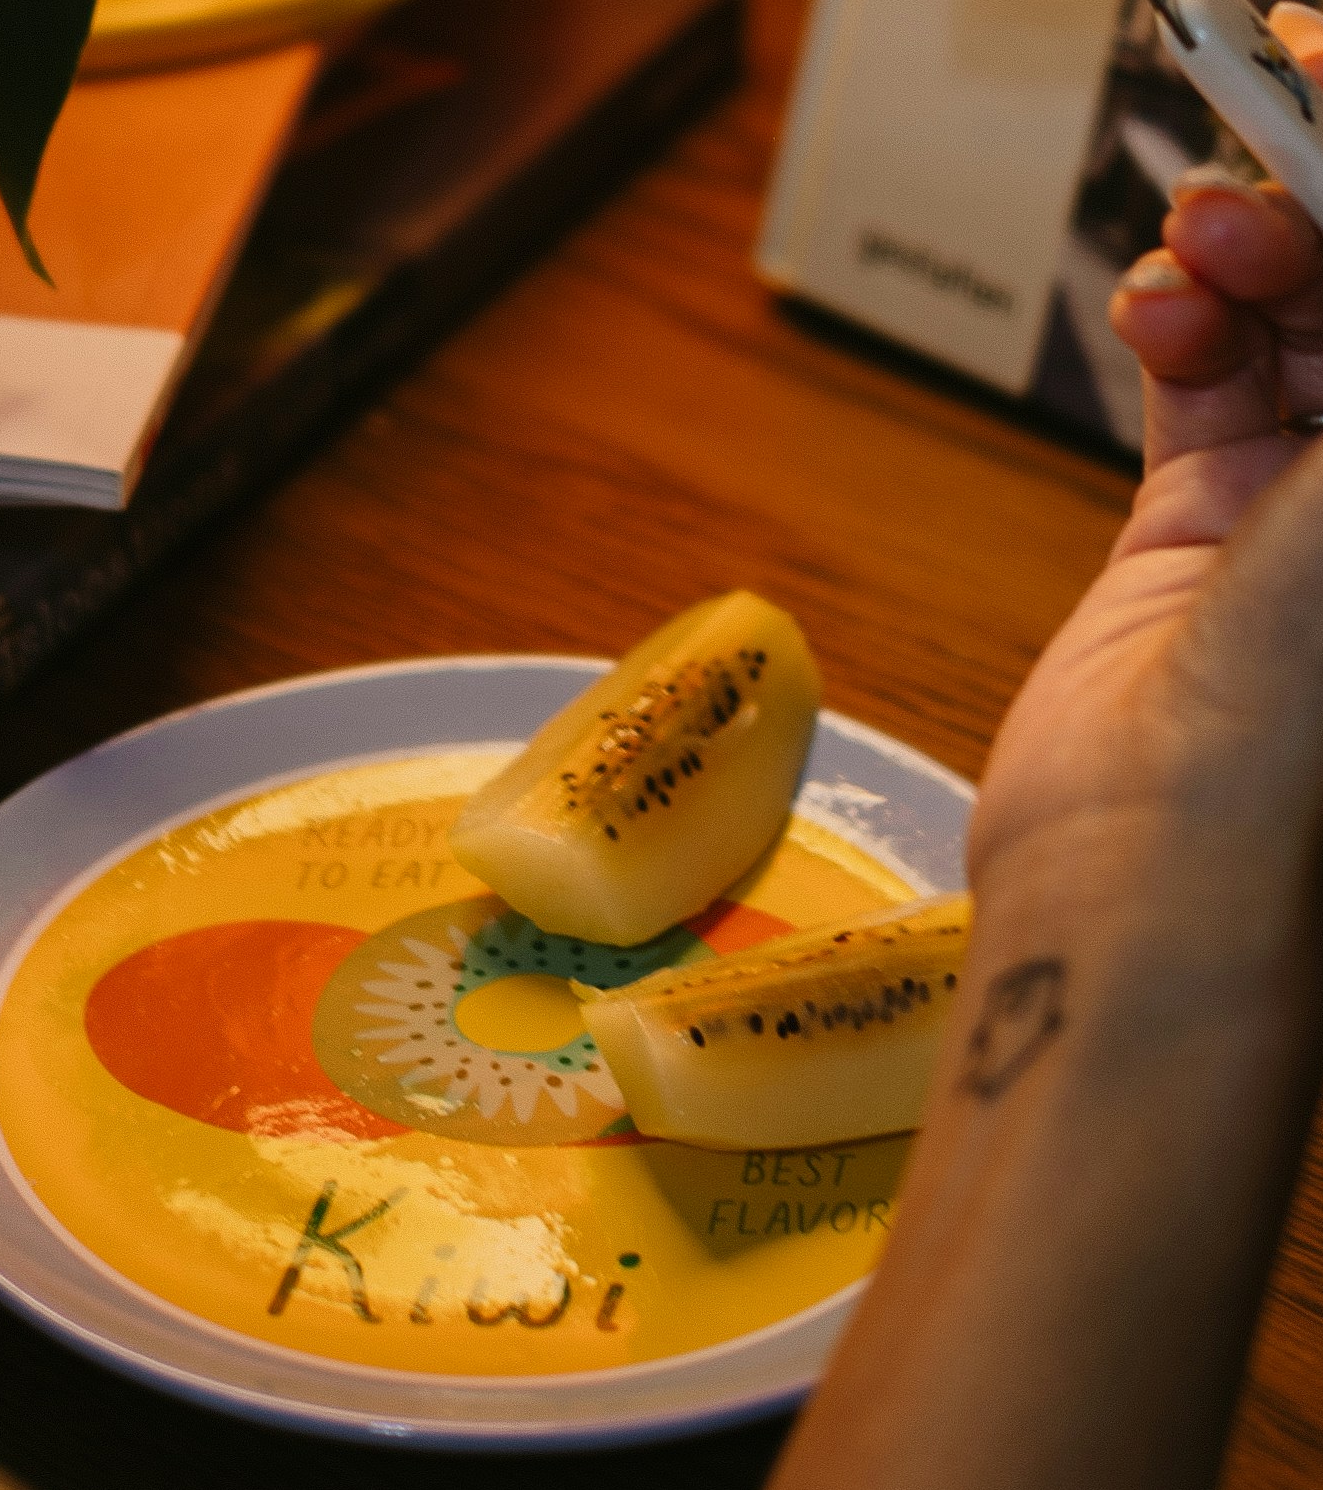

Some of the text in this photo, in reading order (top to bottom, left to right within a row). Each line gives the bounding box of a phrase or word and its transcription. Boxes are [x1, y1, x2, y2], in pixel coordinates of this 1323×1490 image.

[296, 859, 454, 891] TO EAT
[740, 1149, 858, 1187] BEST
[707, 1197, 892, 1236] FLAVOR
[266, 1178, 643, 1333] Kiwi
